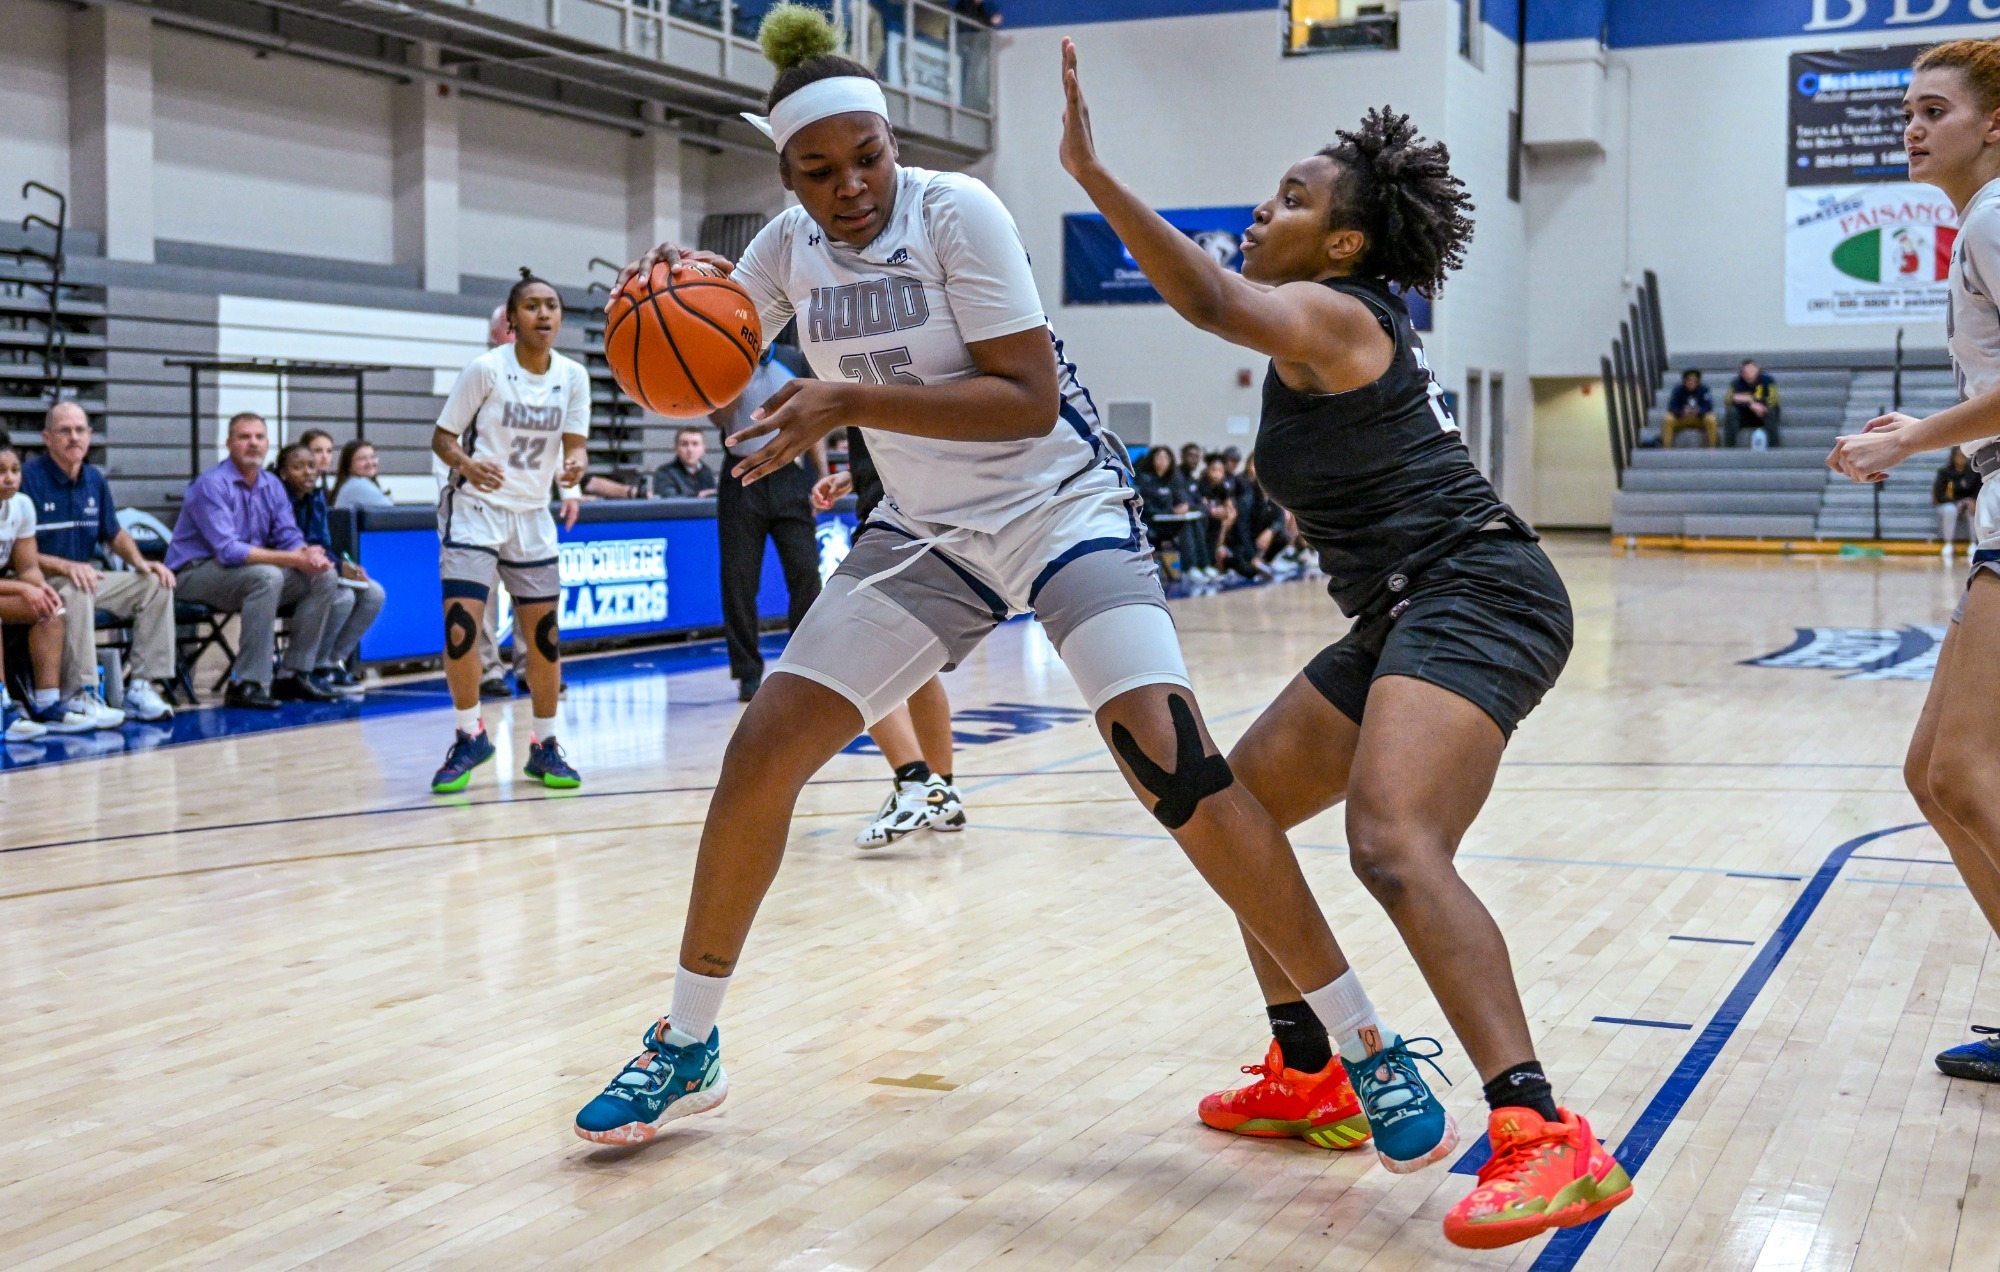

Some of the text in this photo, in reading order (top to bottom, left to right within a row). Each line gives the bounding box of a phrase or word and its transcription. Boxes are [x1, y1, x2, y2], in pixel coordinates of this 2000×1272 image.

[808, 276, 930, 342] HOOD
[502, 401, 562, 431] HOOD
[508, 435, 547, 470] 22
[586, 538, 668, 584] COLLEGE
[558, 581, 668, 631] LAZERS
